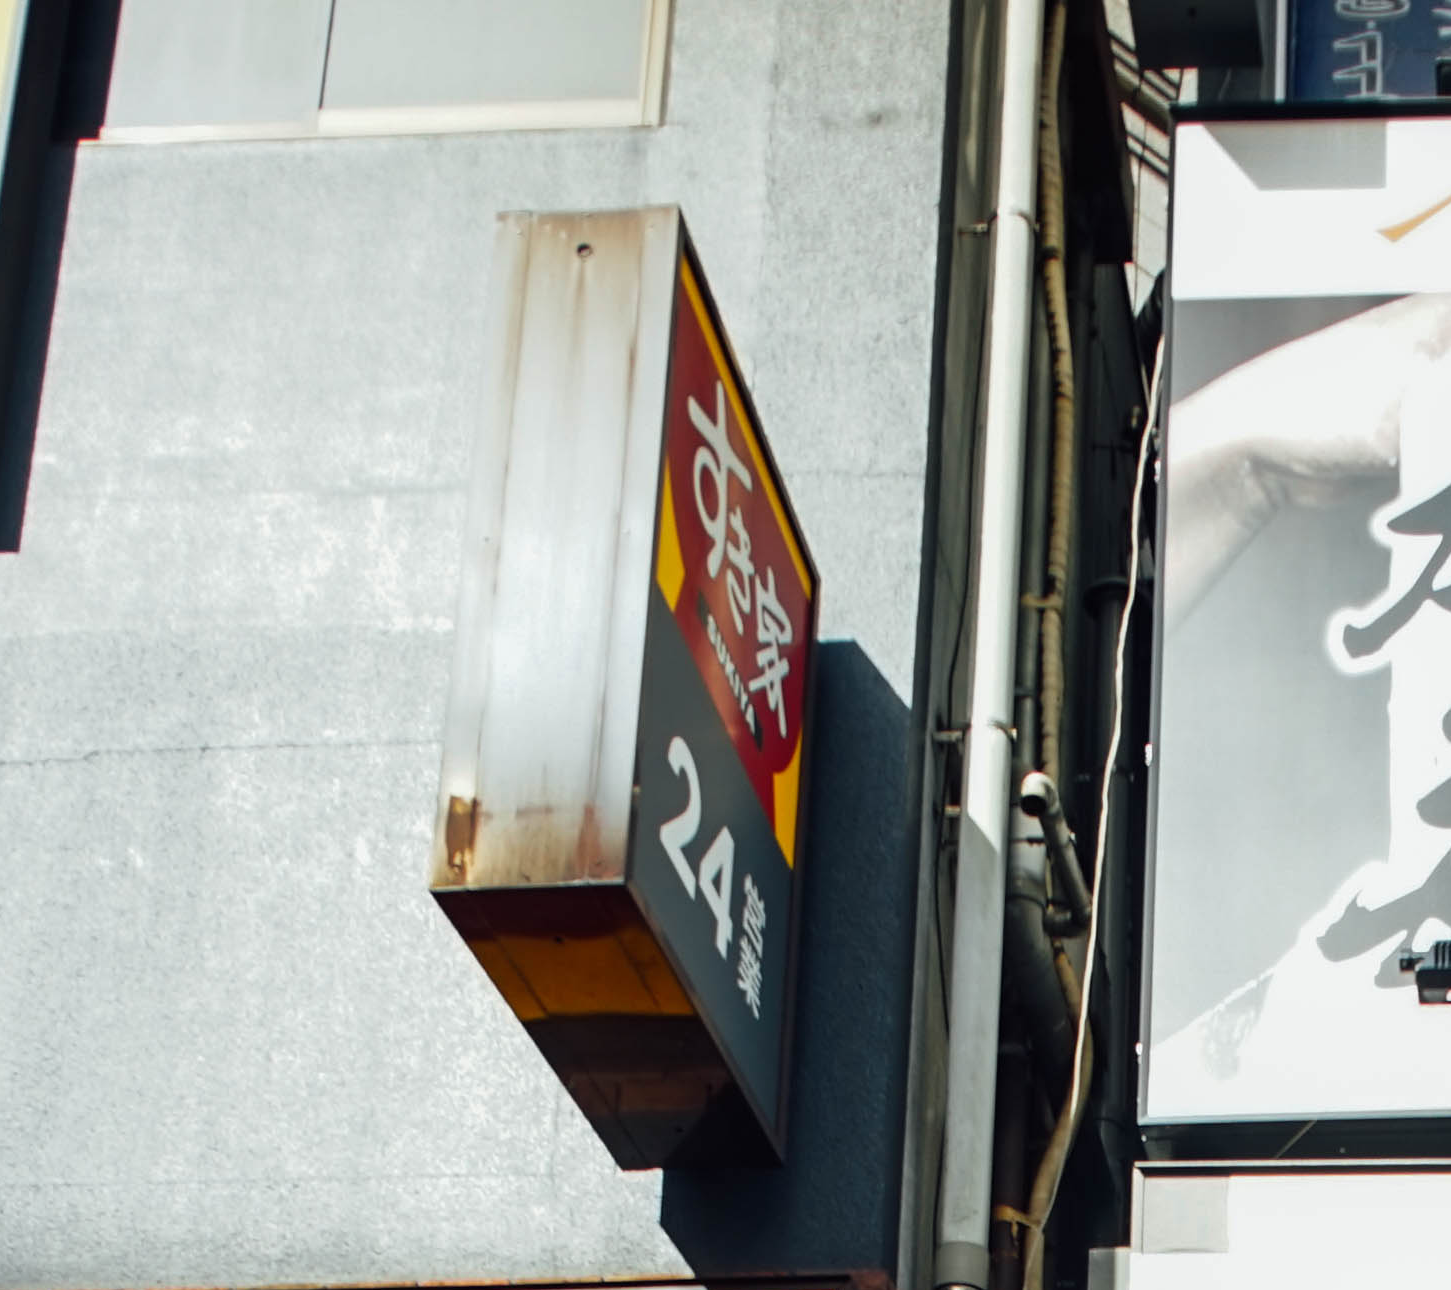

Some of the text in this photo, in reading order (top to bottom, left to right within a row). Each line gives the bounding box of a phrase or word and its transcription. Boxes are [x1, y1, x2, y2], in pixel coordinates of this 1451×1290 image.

[704, 609, 761, 731] SUKIYA
[657, 734, 736, 961] 24
[735, 872, 768, 1021] 営業
